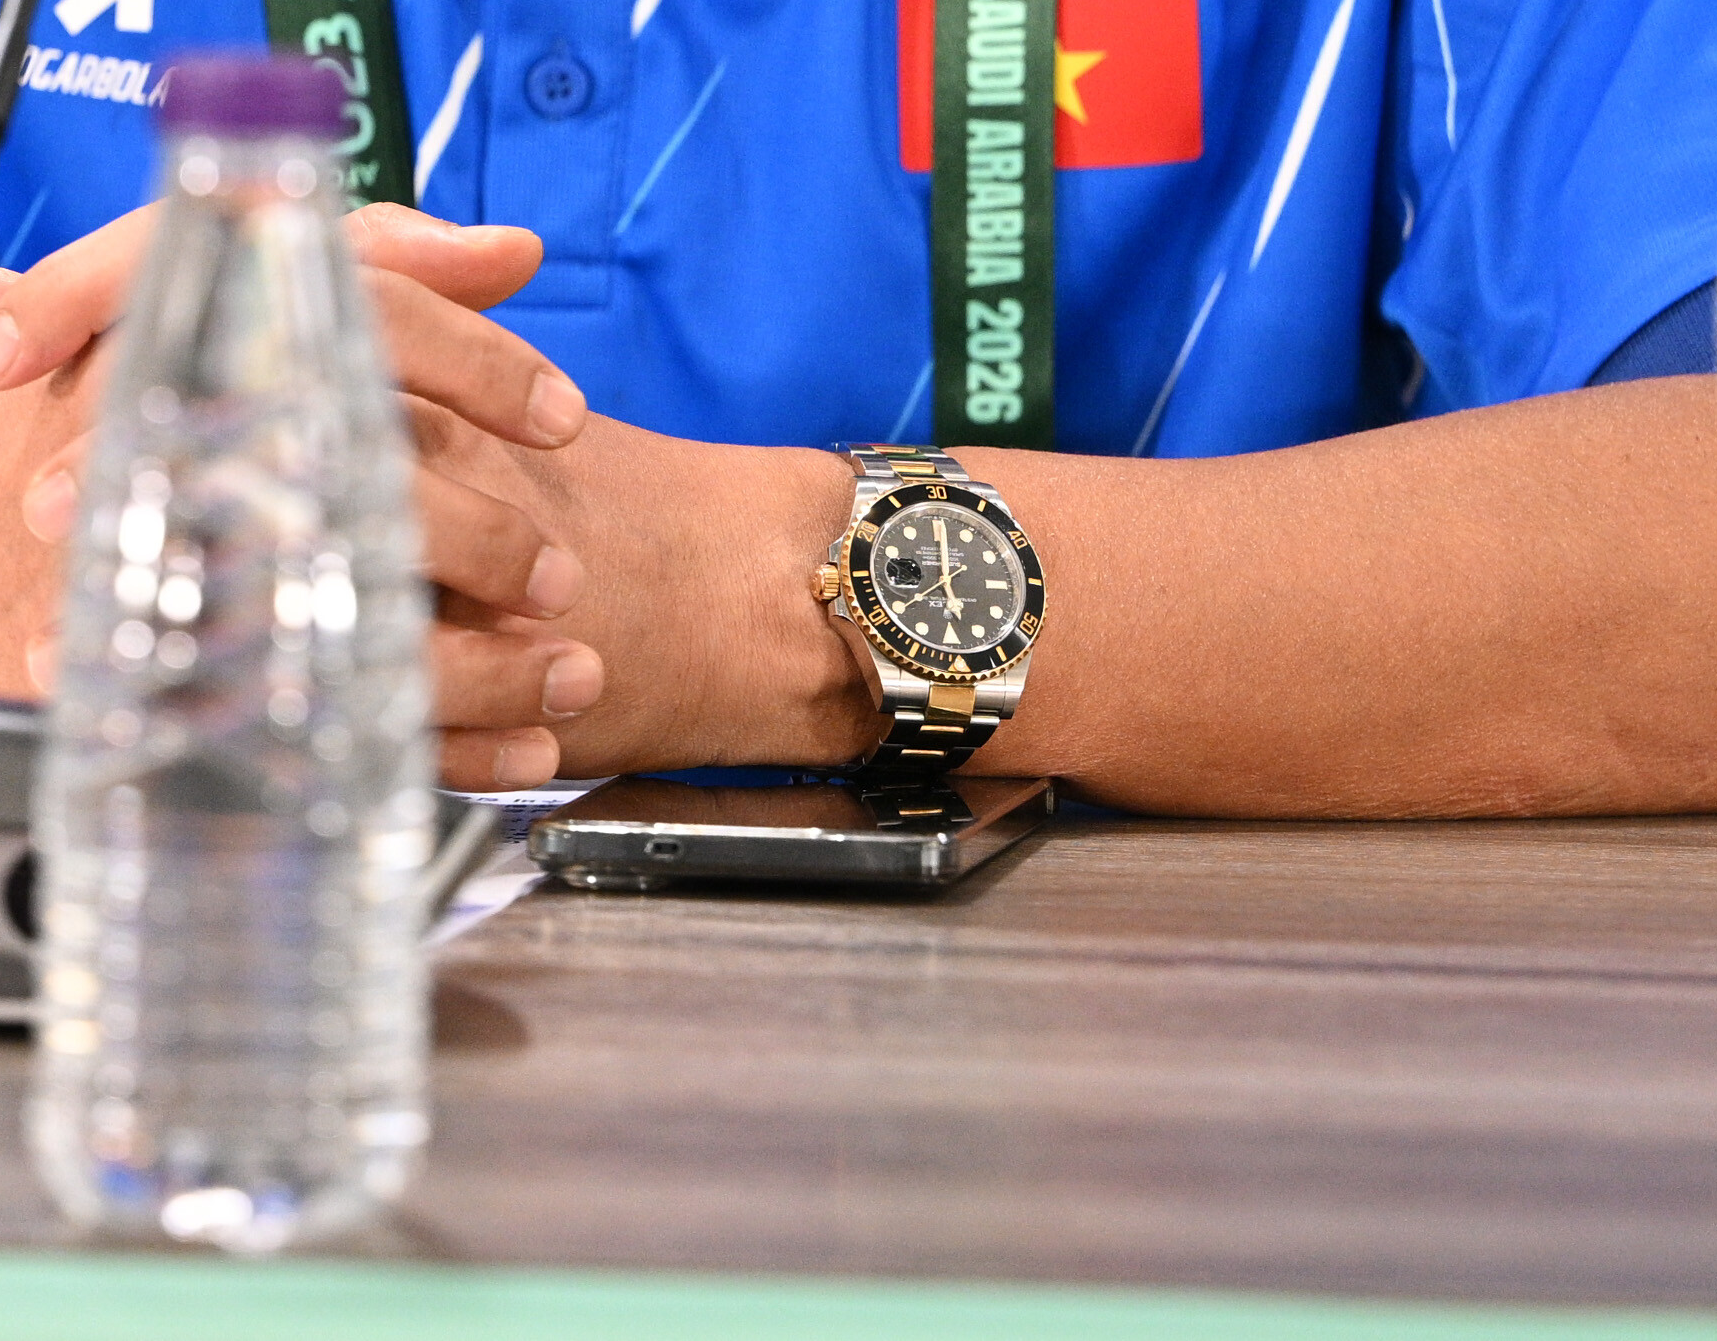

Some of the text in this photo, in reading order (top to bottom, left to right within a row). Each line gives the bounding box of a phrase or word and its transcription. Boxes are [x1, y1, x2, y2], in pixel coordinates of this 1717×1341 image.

[963, 118, 1029, 287] ARABIA
[964, 298, 1025, 423] 2026
[927, 485, 948, 500] 30
[857, 521, 880, 543] 20
[1007, 530, 1029, 550] 40
[1020, 611, 1039, 636] 50
